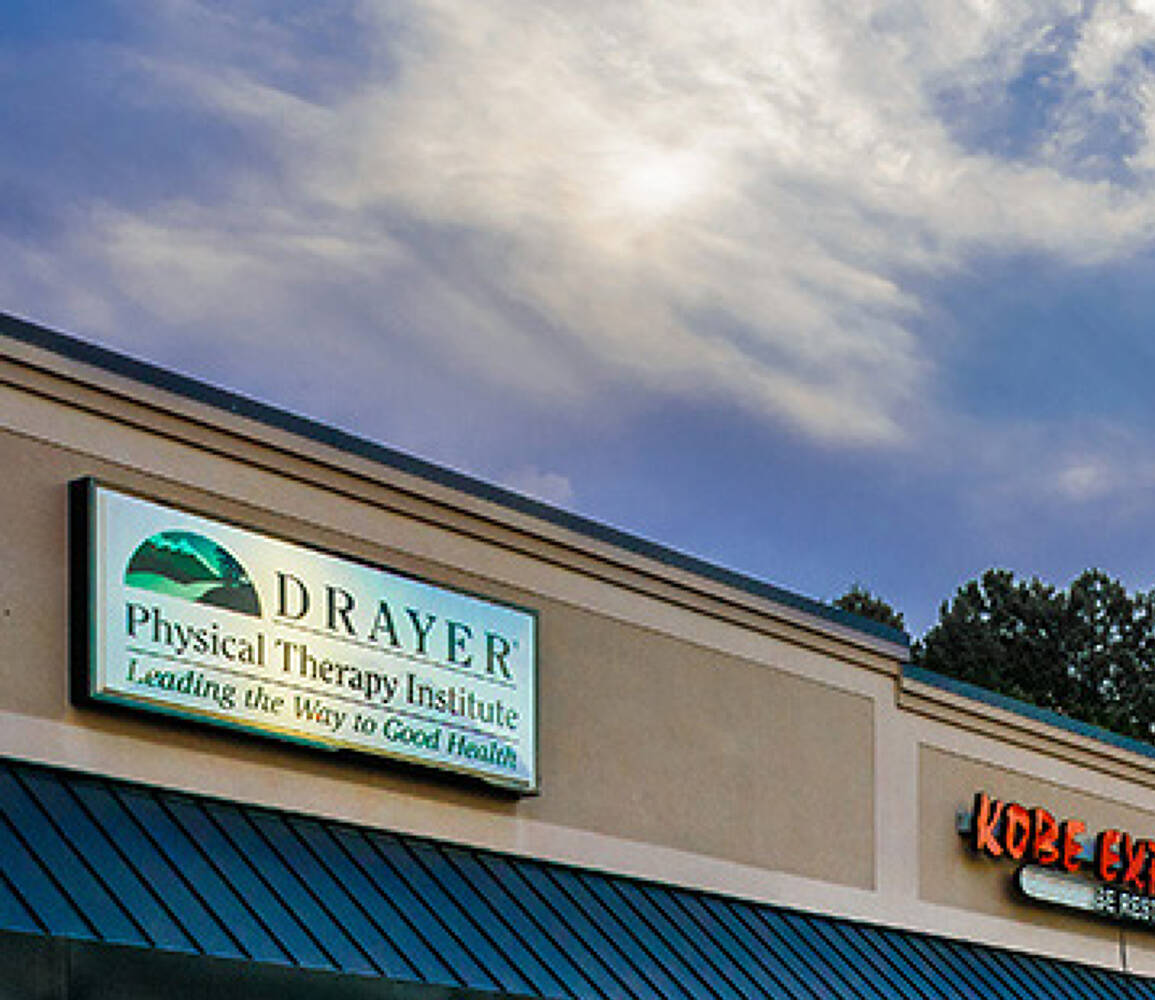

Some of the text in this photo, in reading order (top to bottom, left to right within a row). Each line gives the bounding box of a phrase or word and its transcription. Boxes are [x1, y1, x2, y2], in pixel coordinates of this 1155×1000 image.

[124, 603, 520, 730] Physical Therapy Institute
[275, 571, 516, 680] DRAYER
[126, 659, 518, 770] Leading the Way to Good Health
[975, 792, 1085, 872] KOBE
